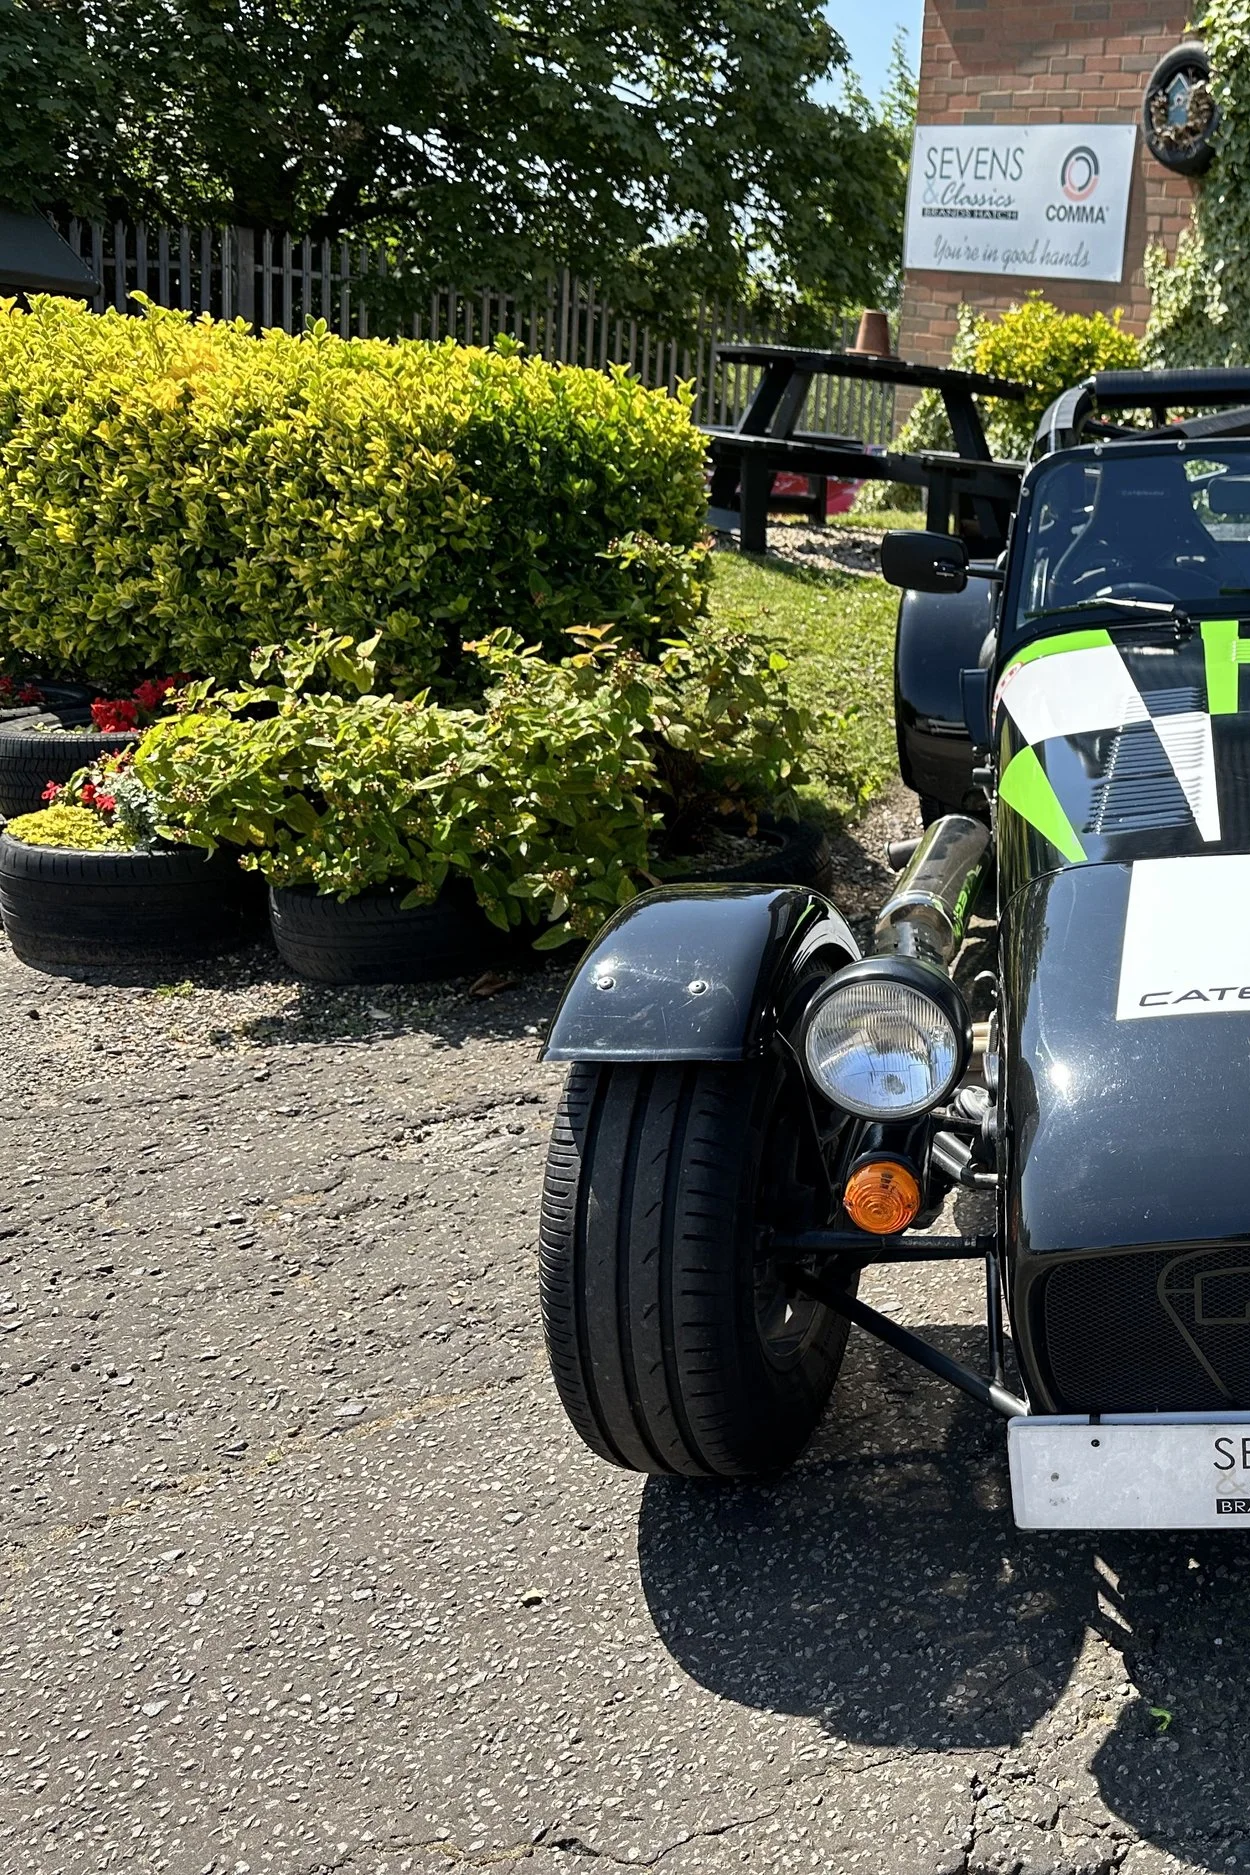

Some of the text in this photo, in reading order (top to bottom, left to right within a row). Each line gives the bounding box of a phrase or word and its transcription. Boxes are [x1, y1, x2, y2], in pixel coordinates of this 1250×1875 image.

[924, 146, 1025, 182] SEVENS
[940, 181, 1015, 208] Classics
[1046, 204, 1106, 224] COMMA
[933, 233, 1091, 271] You're in good hands
[1215, 1468, 1249, 1496] &
